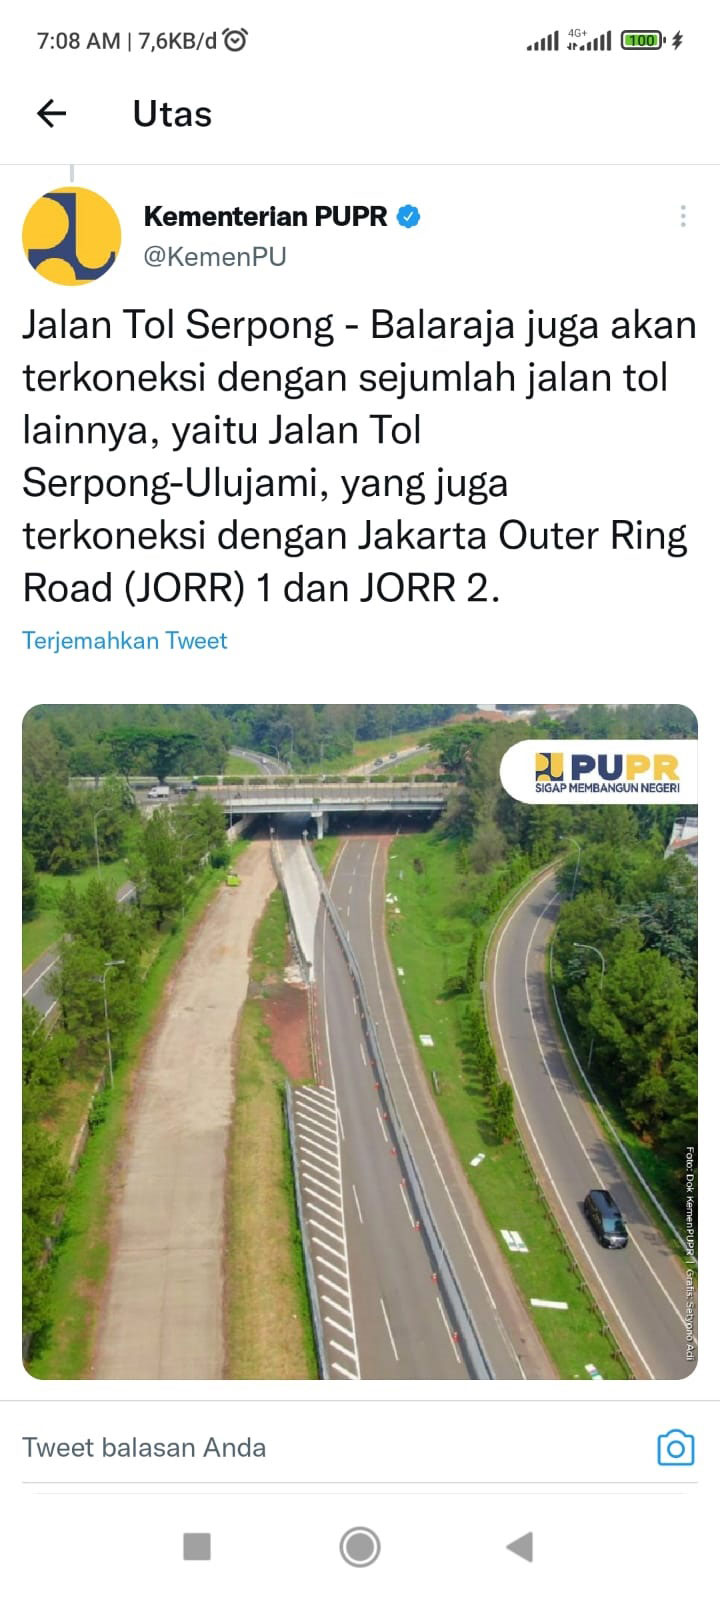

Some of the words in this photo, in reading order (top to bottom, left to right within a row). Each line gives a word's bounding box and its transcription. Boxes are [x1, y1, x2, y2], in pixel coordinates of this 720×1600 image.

[37, 32, 80, 49] 7:08
[87, 33, 120, 49] AM
[139, 32, 217, 52] 7,6KB/d
[567, 29, 588, 38] 4G+
[629, 35, 655, 47] 100
[134, 100, 212, 128] Utas
[145, 206, 307, 227] Kementerian
[316, 206, 388, 227] PUPR
[145, 246, 286, 268] @KemenPU
[22, 309, 110, 339] Jalan
[123, 309, 173, 339] Tol
[187, 309, 334, 347] Serpong
[373, 309, 514, 347] Balaraja
[525, 309, 598, 347] juga
[612, 309, 696, 339] akan
[22, 361, 205, 391] terkoneksi
[218, 361, 346, 399] dengan
[360, 361, 514, 399] sejumlah
[526, 361, 610, 399] jalan
[623, 361, 667, 391] tol
[24, 414, 159, 451] lainnya,
[172, 414, 257, 451] yaitu
[269, 414, 357, 444] Jalan
[369, 414, 420, 444] Tol
[23, 467, 328, 505] Serpong-Ulujami,
[341, 472, 425, 505] yang
[434, 467, 508, 505] juga
[22, 519, 205, 549] terkoneksi
[218, 519, 346, 557] dengan
[358, 519, 486, 549] Jakarta
[500, 519, 599, 549] Outer
[611, 520, 688, 557] Ring
[24, 572, 112, 602] Road
[125, 570, 244, 607] (JORR)
[257, 572, 269, 602] 1
[284, 572, 348, 602] dan
[360, 572, 455, 602] JORR
[467, 572, 499, 602] 2.
[22, 631, 159, 653] Terjemahkan
[165, 631, 228, 650] Tweet
[22, 1437, 94, 1458] Tweet
[103, 1437, 195, 1458] balasan
[203, 1437, 266, 1458] Anda
